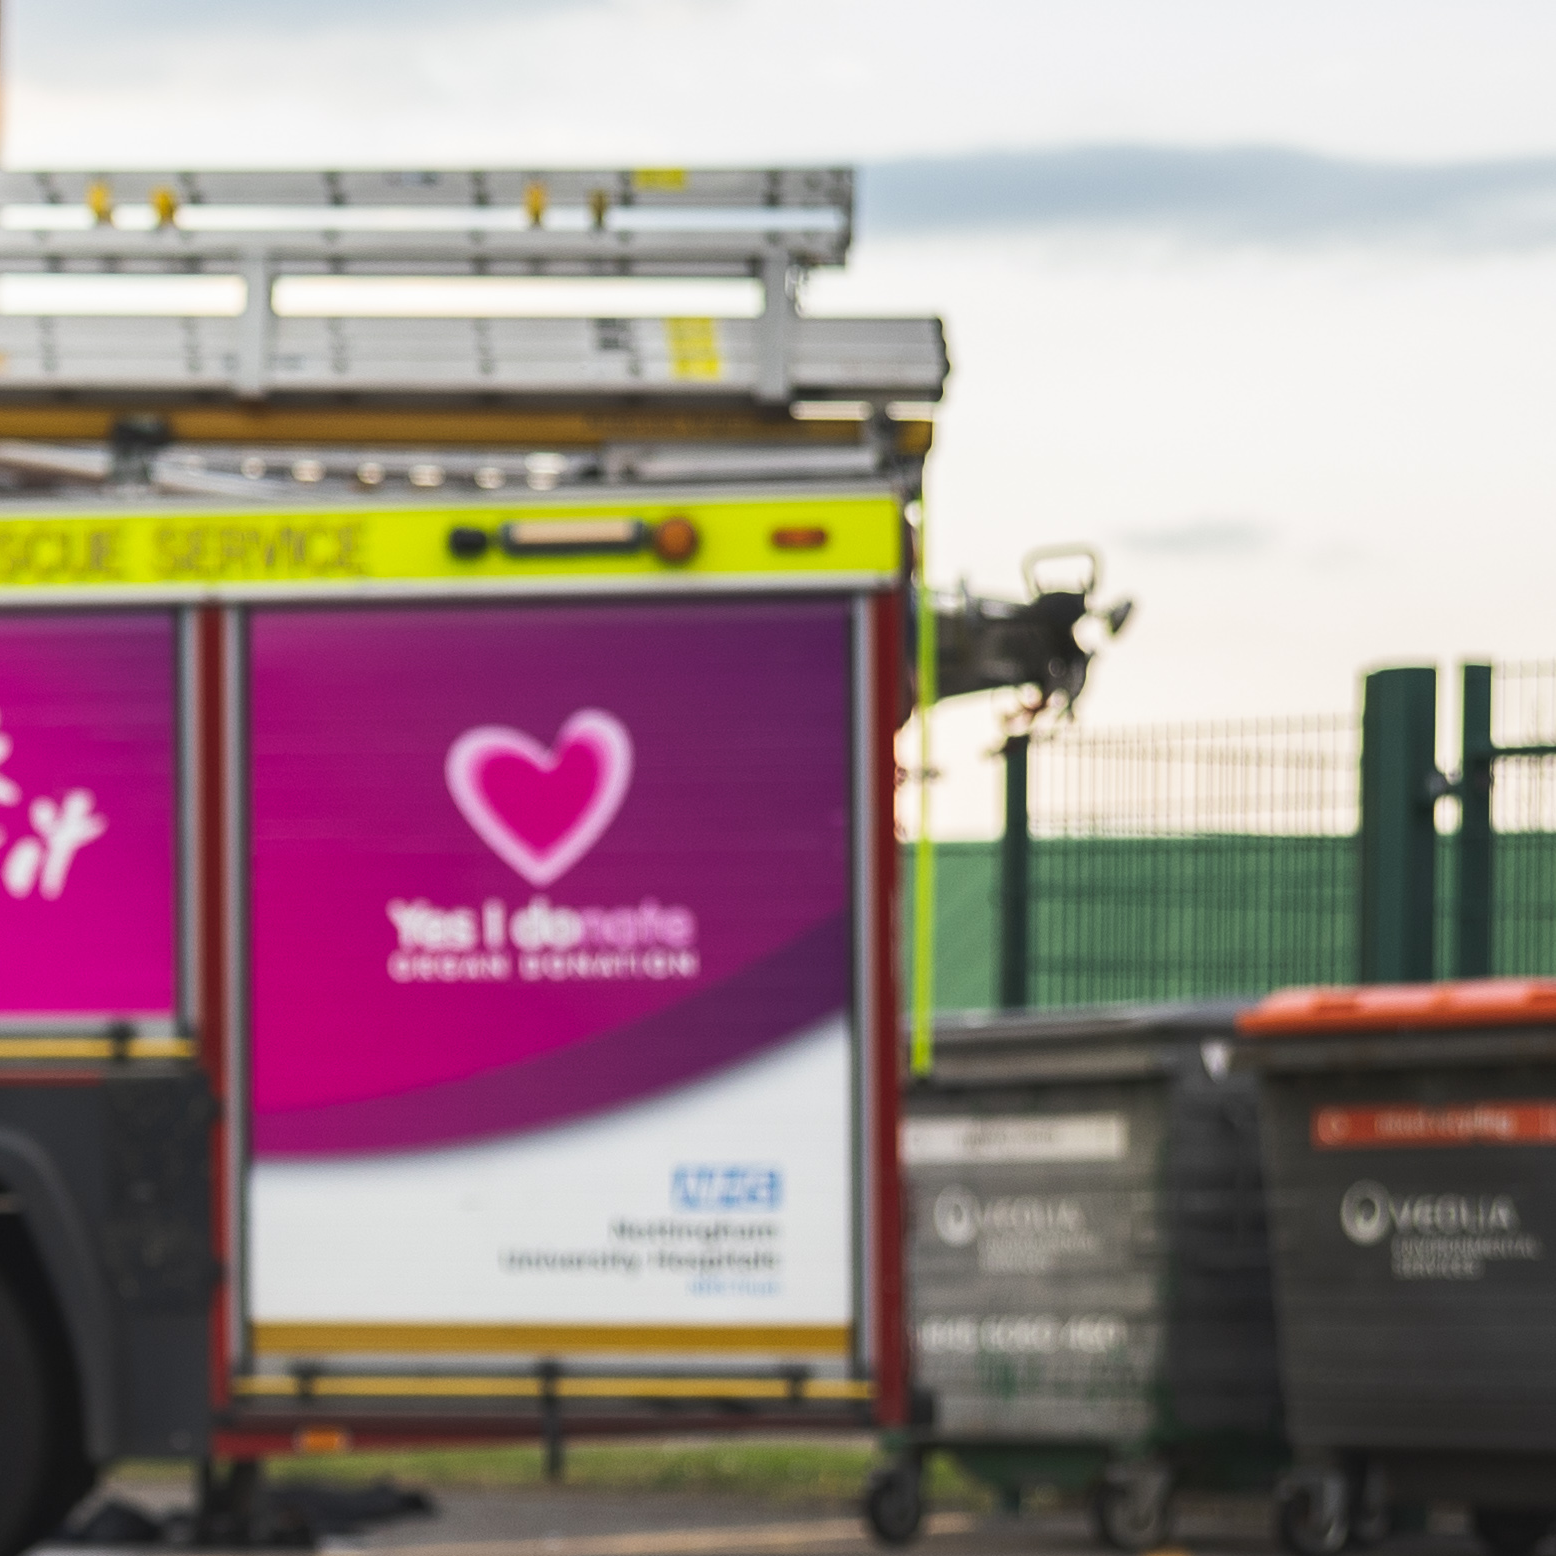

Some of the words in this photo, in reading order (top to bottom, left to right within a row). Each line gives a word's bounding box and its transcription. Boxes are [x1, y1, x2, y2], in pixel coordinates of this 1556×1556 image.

[152, 518, 369, 578] SERVICE
[2, 787, 109, 899] it
[385, 897, 477, 951] Yes
[482, 897, 507, 950] I
[509, 894, 697, 951] donate
[518, 948, 701, 981] DONATION
[1387, 1194, 1521, 1232] VEOLIA
